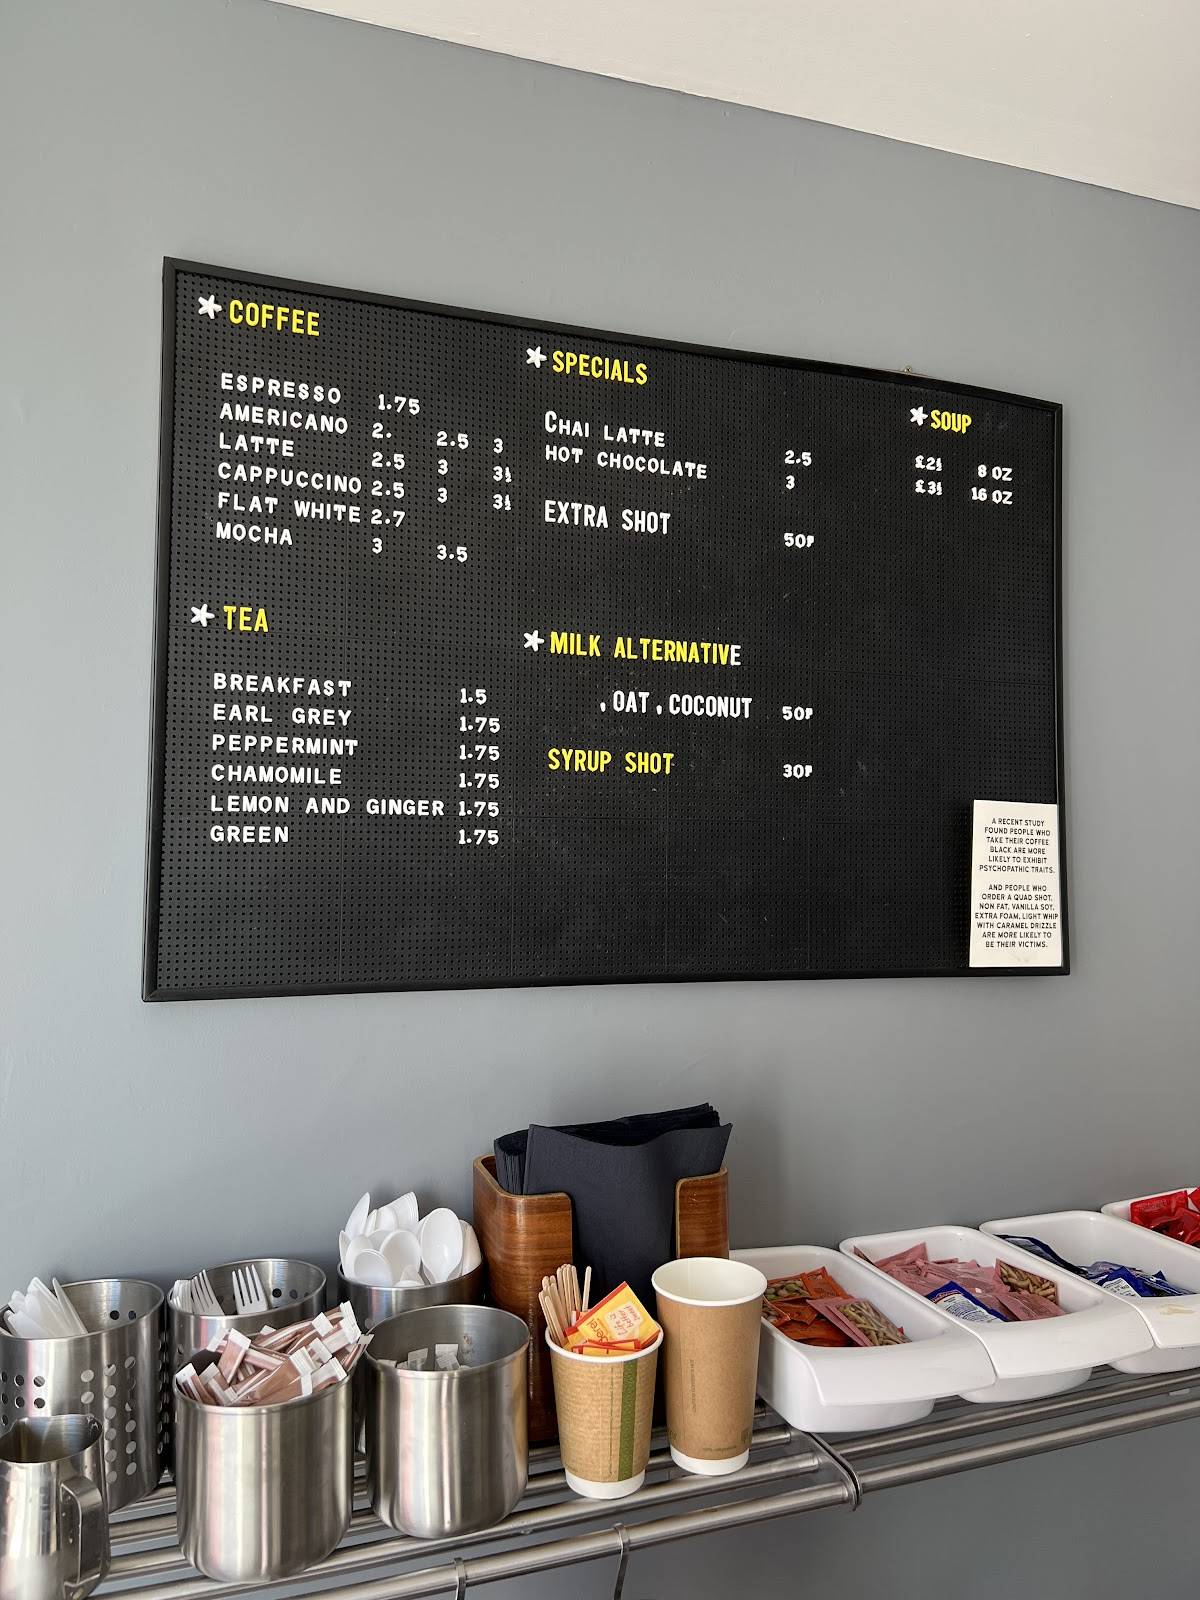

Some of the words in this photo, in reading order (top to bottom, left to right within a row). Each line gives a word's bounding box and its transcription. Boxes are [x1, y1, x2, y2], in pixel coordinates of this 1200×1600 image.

[229, 299, 320, 337] COFFEE
[552, 350, 648, 386] SPECIALS
[220, 372, 341, 405] ESPRESSO
[377, 393, 421, 416] 1.75
[219, 402, 348, 435] AMERICANO
[436, 430, 469, 450] 2.5
[492, 437, 504, 454] 3
[930, 409, 972, 435] SOUP
[219, 431, 295, 458] LATTE
[371, 451, 406, 471] 2.5
[437, 458, 449, 476] 3
[603, 424, 666, 448] LATTE
[784, 449, 812, 467] 2.5
[545, 444, 584, 464] HOT
[596, 451, 708, 480] CHOCOLATE
[785, 474, 795, 490] 3
[977, 464, 987, 478] 8
[991, 466, 1013, 482] OZ
[217, 461, 362, 495] CAPPUCCINO
[371, 480, 405, 499] 2.5
[436, 487, 448, 504] 3
[971, 486, 988, 502] 16
[991, 489, 1013, 505] OZ
[217, 491, 279, 514] FLAT
[293, 499, 361, 524] WHITE
[370, 508, 406, 528] 2.7
[544, 499, 609, 529] EXTRA
[621, 508, 671, 535] SHOT
[215, 521, 293, 546] MOCHA
[371, 537, 383, 554] 3
[436, 544, 468, 563] 3.5
[223, 605, 269, 633] TEA
[549, 630, 601, 657] MILK
[613, 636, 742, 666] ALTERNATIVE
[213, 672, 352, 697] BREAKFAST
[460, 687, 487, 706] 1.5
[213, 703, 273, 723] EARL
[291, 707, 352, 727] GREY
[459, 715, 501, 734] 1.75
[212, 733, 359, 756] PEPPERMINT
[459, 744, 500, 762] 1.75
[547, 747, 612, 773] SYRUP
[625, 751, 675, 775] SHOT
[211, 763, 342, 785] CHAMOMILE
[458, 772, 500, 790] 1.75
[210, 794, 289, 814] LEMON
[305, 797, 351, 815] AND
[366, 798, 445, 817] GINGER
[458, 800, 500, 818] 1.75
[209, 824, 289, 844] GREEN
[458, 828, 499, 846] 1.75
[984, 826, 1008, 834] FOUND
[1009, 828, 1034, 836] PEOPLE
[1035, 829, 1051, 837] WHO
[991, 817, 997, 825] A
[997, 817, 1023, 826] RECENT
[1024, 819, 1045, 827] STUDY
[986, 836, 1004, 844] TAKE
[1025, 838, 1049, 846] COFFEE
[989, 845, 1012, 853] BLACK
[1027, 847, 1046, 855] MORE
[979, 864, 1030, 873] PSYCHOPATHIC
[988, 855, 1011, 863] LIKELY
[1022, 856, 1048, 864] EXHIBIT
[981, 893, 1005, 901] ORDER
[1013, 893, 1033, 901] QUAD
[1004, 884, 1030, 892] PEOPLE
[1011, 903, 1039, 911] VANILLA
[1022, 912, 1041, 920] LIGHT
[982, 931, 996, 939] ARE
[997, 931, 1018, 939] MORE
[1019, 931, 1041, 939] LIKELY
